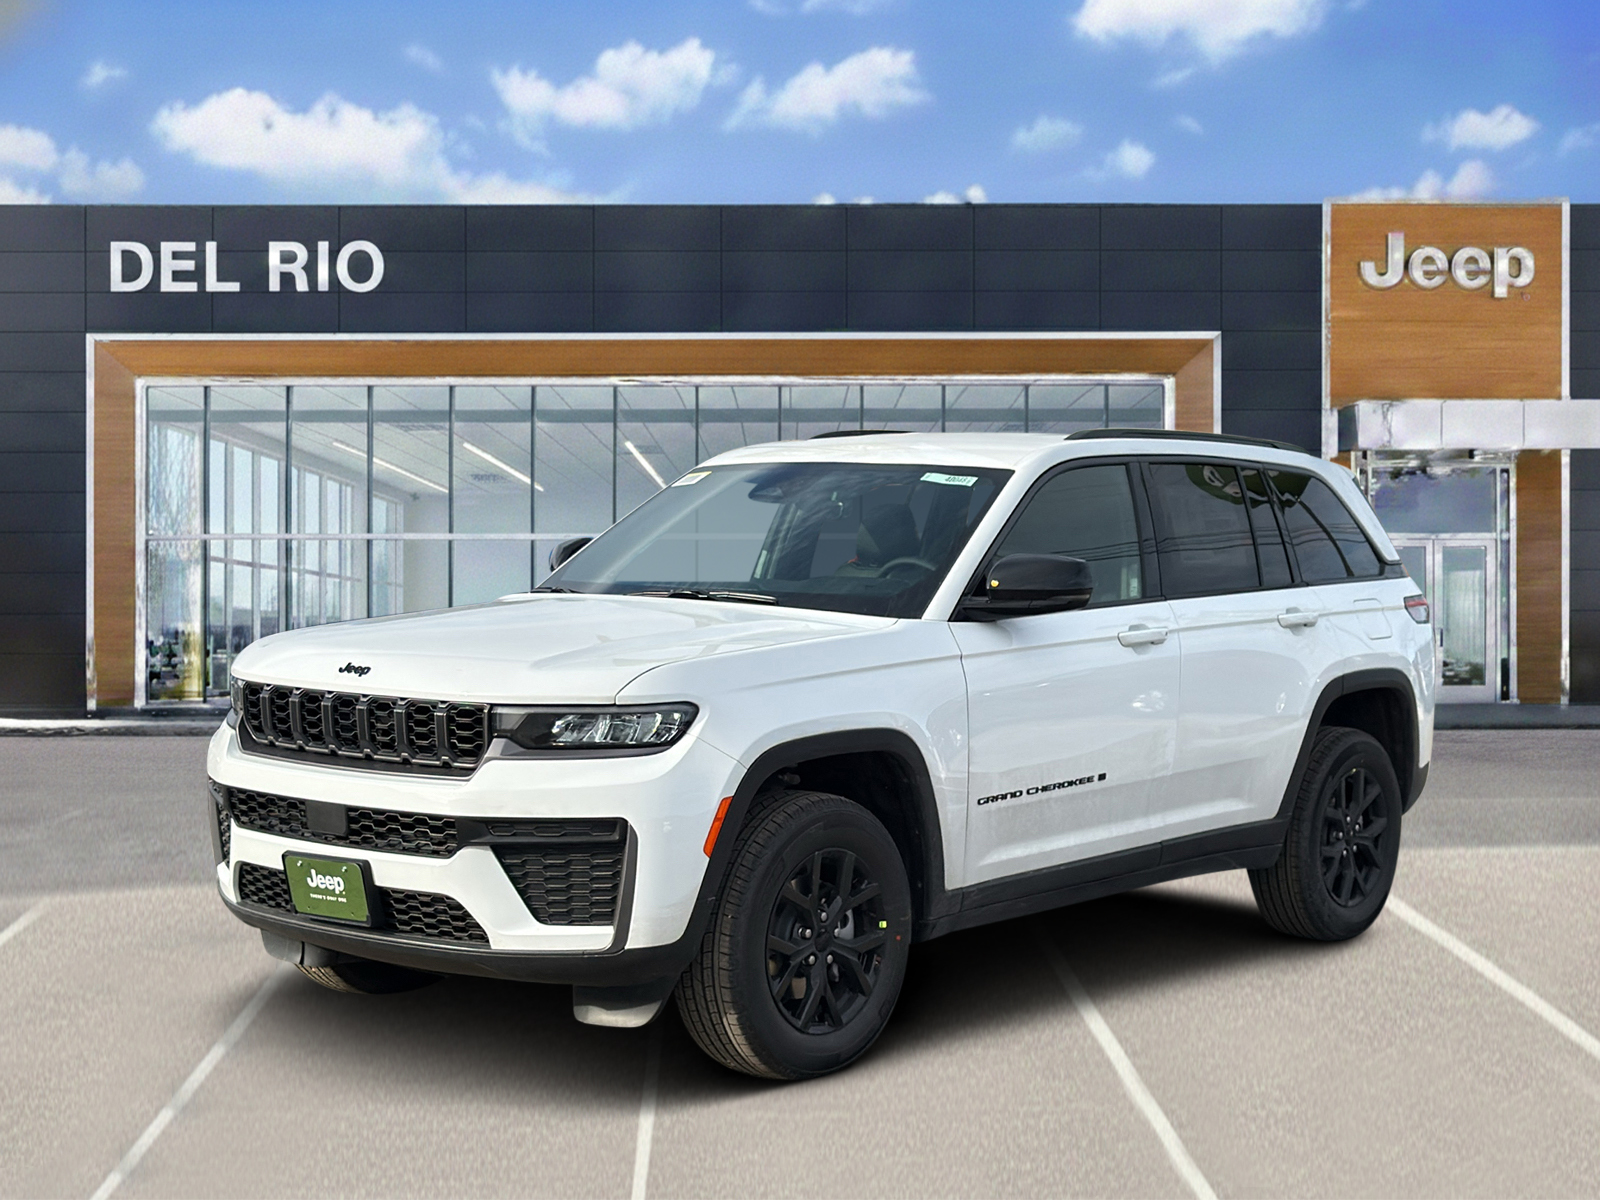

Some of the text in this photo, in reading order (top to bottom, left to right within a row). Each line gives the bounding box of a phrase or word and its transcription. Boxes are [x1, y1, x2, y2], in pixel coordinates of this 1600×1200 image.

[110, 240, 384, 293] DEL RIO
[1360, 231, 1535, 298] Jeep
[338, 662, 371, 677] Jeep
[977, 775, 1095, 805] GRAND CHEROKEE
[306, 869, 344, 894] Jeep
